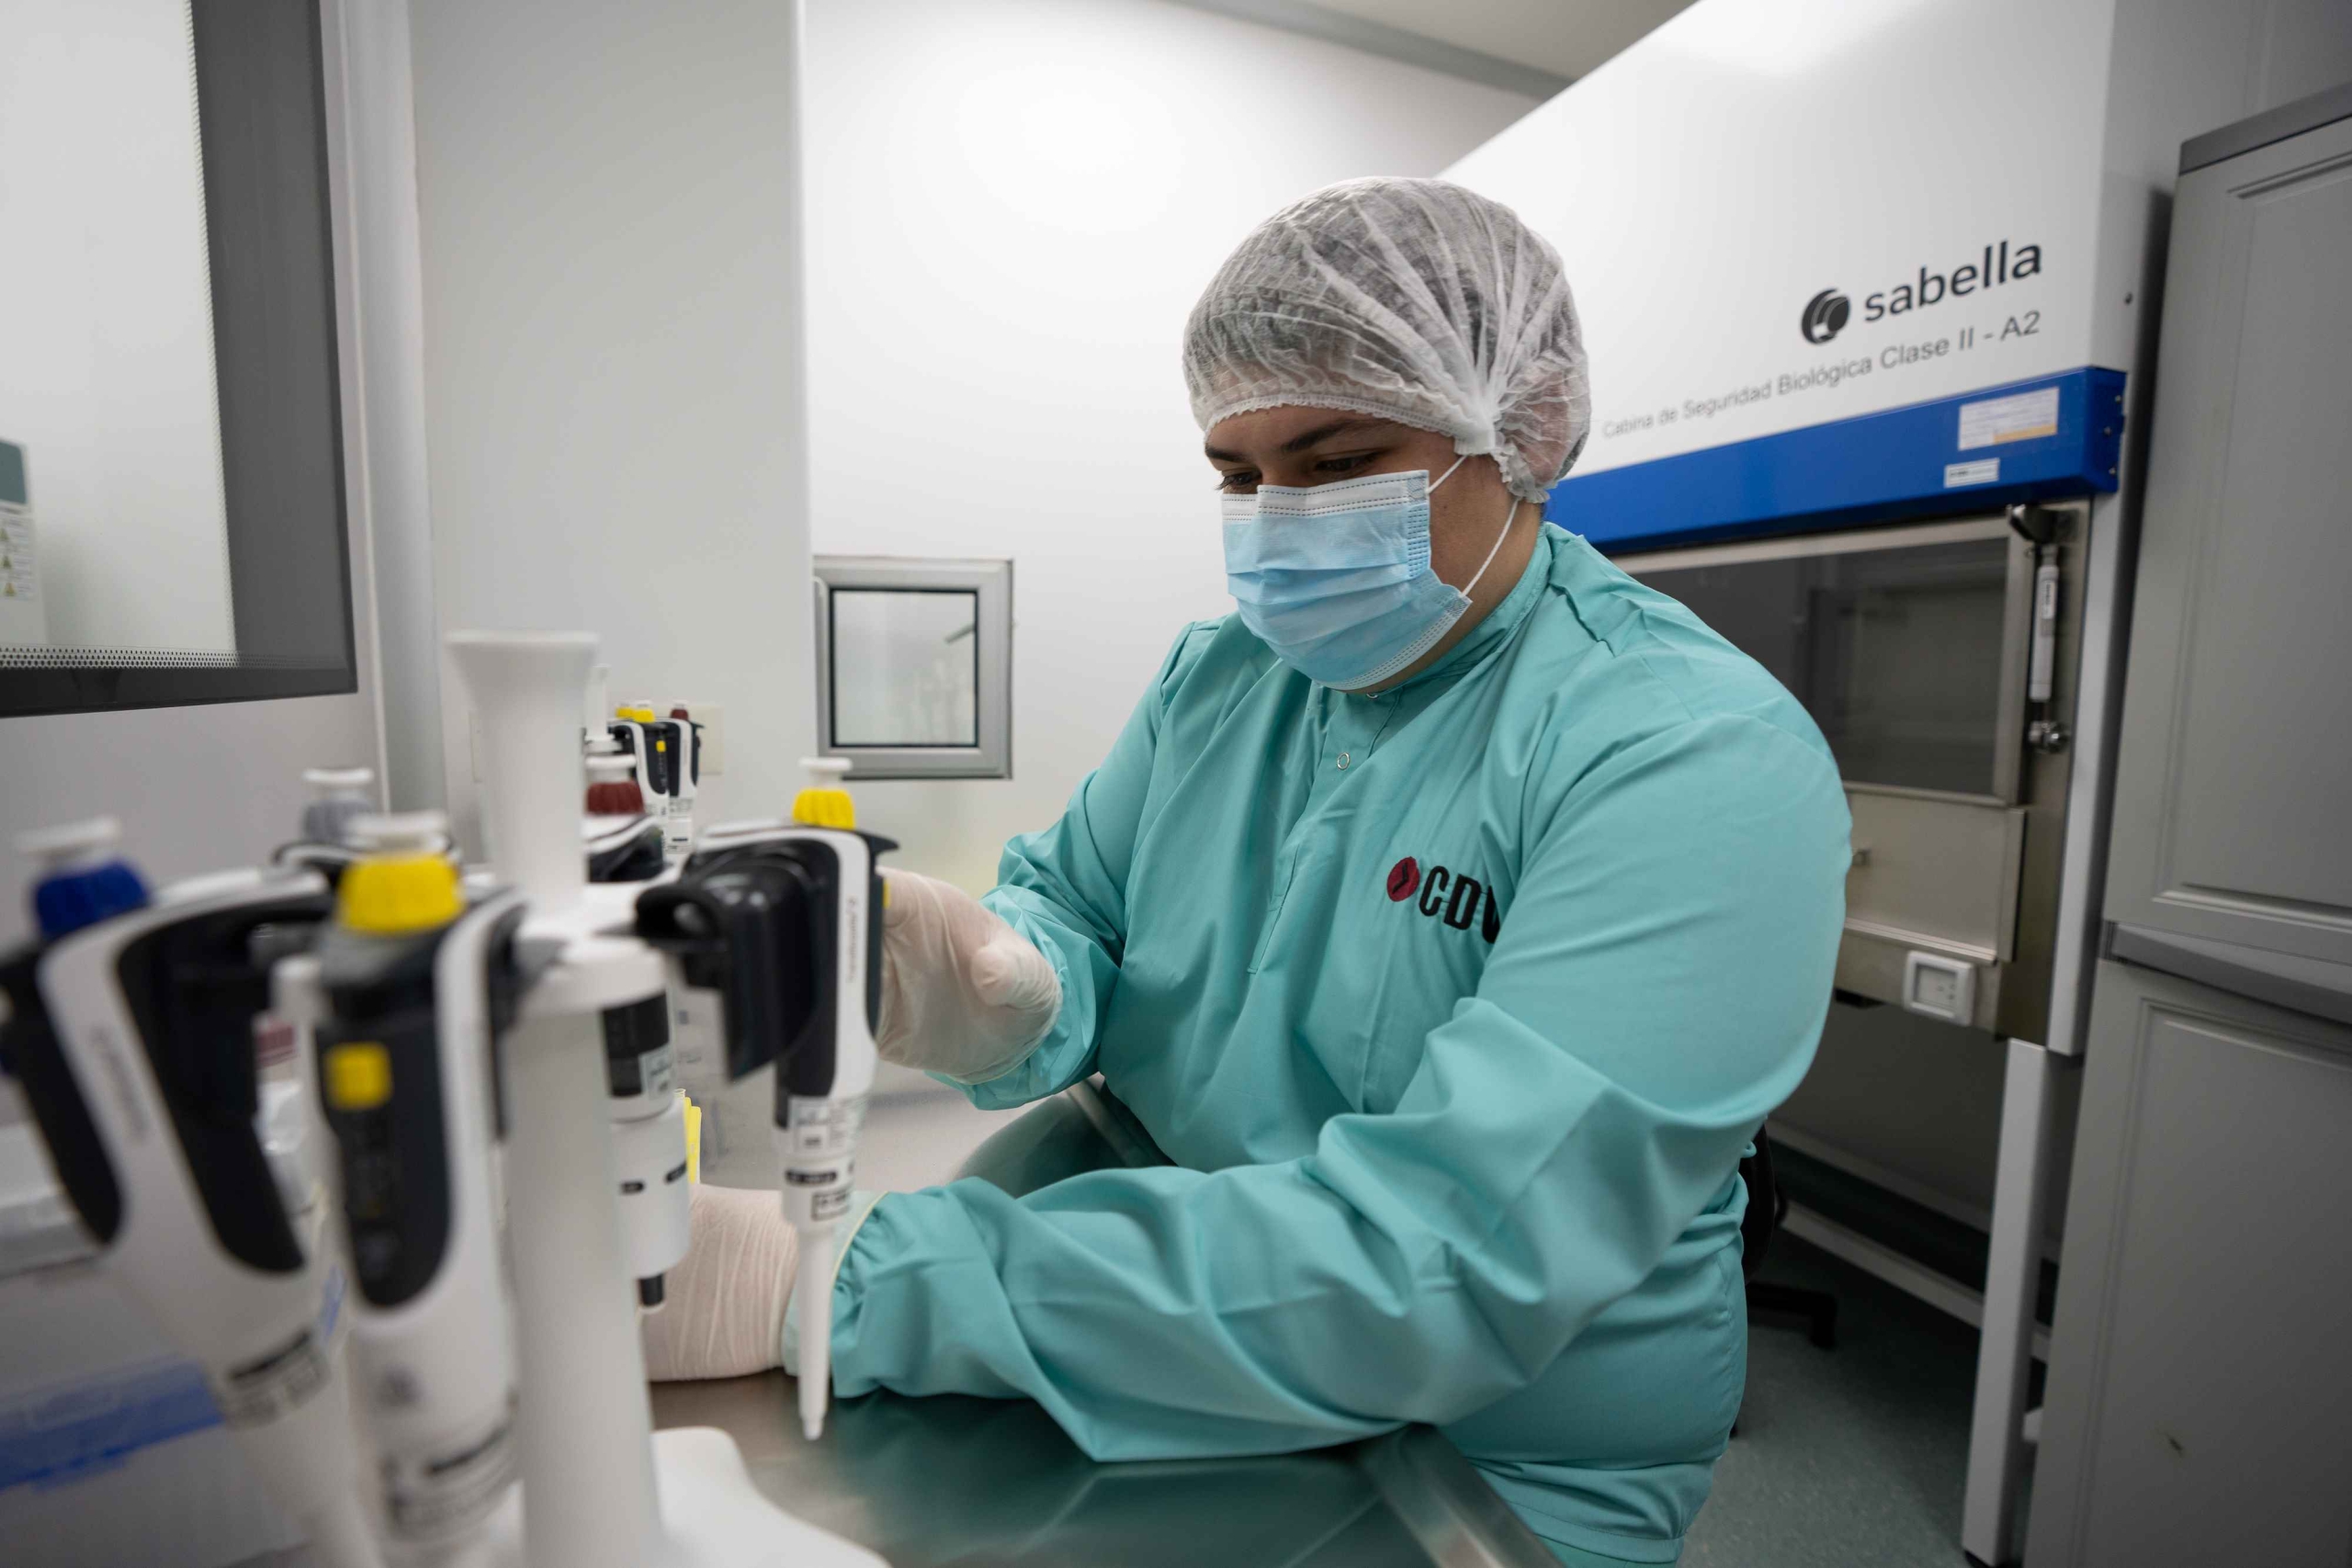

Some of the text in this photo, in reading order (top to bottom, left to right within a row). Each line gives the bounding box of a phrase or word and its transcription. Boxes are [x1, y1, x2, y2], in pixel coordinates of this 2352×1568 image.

[1864, 239, 2042, 322] sabella
[1602, 413, 1654, 438] Cabina
[1659, 407, 1679, 425] de
[1682, 378, 1773, 419] Seguridad
[1777, 355, 1872, 396] Biológica
[1879, 335, 1950, 369] Clase
[1999, 310, 2041, 342] A2
